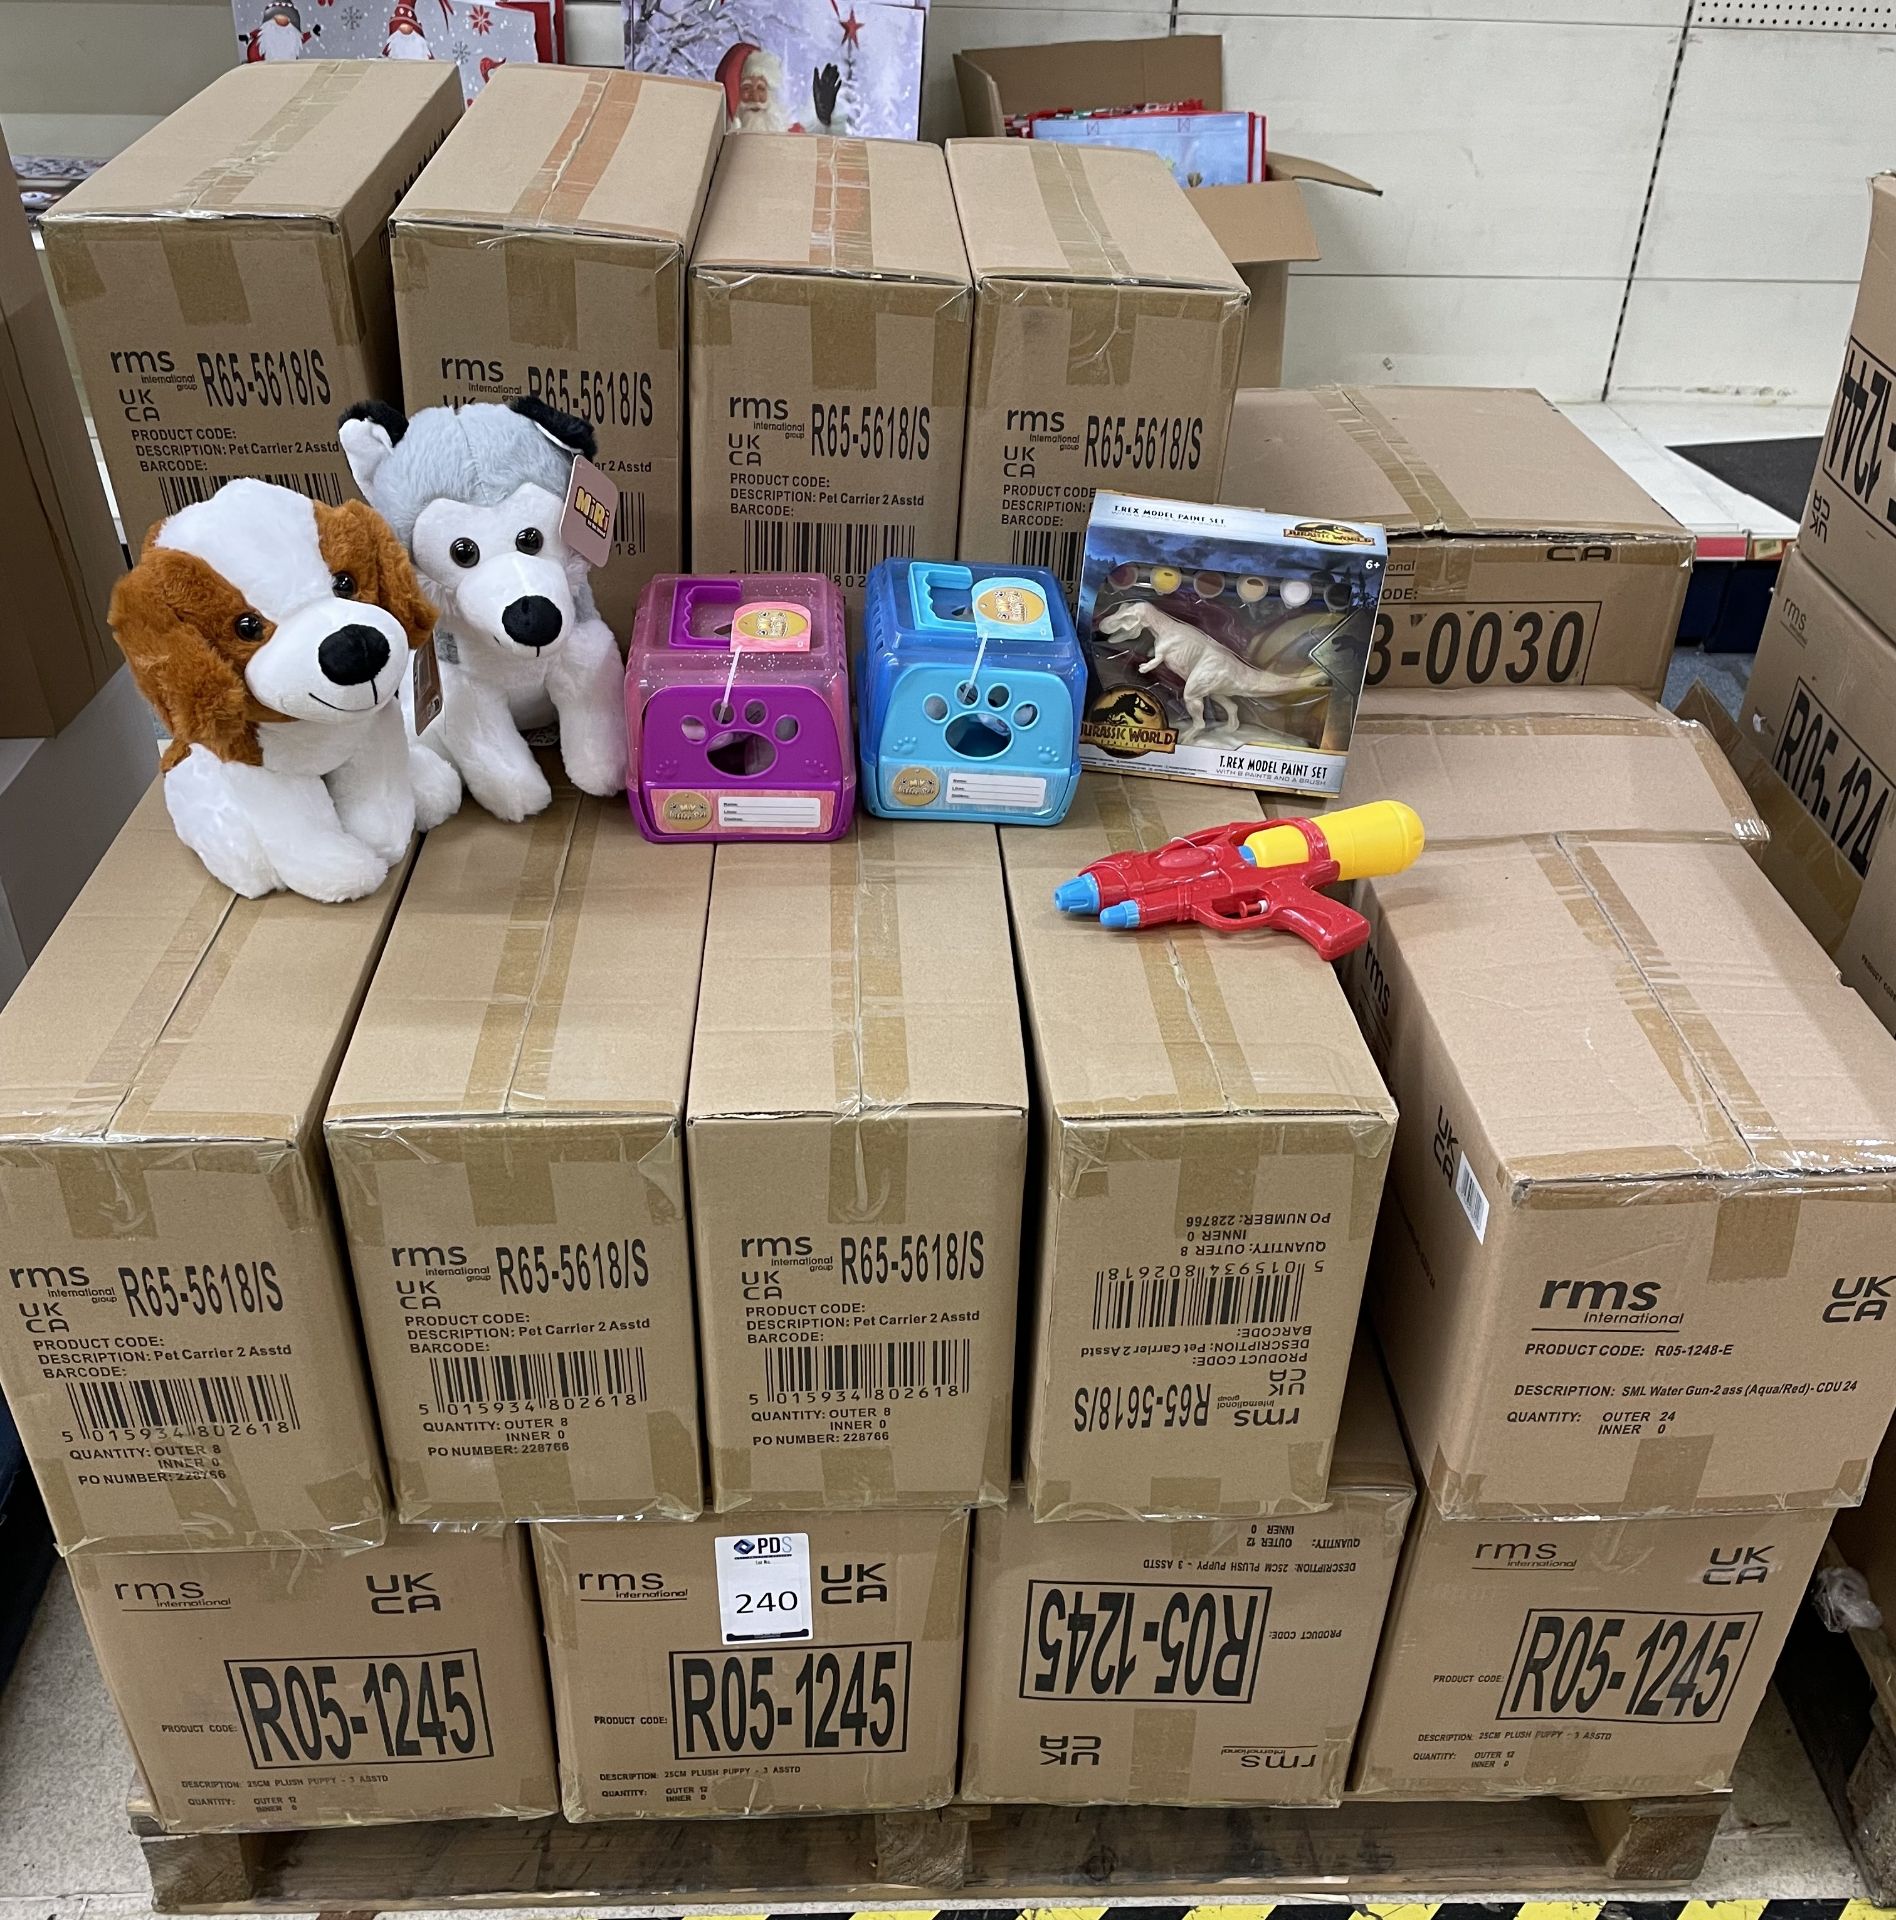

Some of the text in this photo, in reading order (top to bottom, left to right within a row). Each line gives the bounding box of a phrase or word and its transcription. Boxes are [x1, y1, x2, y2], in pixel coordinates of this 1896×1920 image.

[110, 351, 175, 373] rms
[441, 357, 504, 382] rms
[197, 349, 331, 408] R65-5618/S
[528, 366, 653, 426] R65-5618/S
[729, 396, 789, 419] rms
[1007, 409, 1065, 432] rms
[131, 428, 237, 441] PRODUCT CODE:
[811, 404, 930, 460] R65-5618/S
[136, 442, 339, 456] DESCRIPTION: Pet Carrier Asstd
[1084, 416, 1203, 470] R65-5618/S
[140, 460, 207, 471] BARCODE:
[617, 461, 652, 472] Asstd
[730, 473, 830, 488] PRODUCT CODE:
[730, 488, 924, 506] DESCRIPTION: Pet Carrier Asstd
[1003, 485, 1096, 498] PRODUCT CODE
[730, 504, 794, 517] BARCODE:
[1002, 500, 1086, 513] DESCRIPTION:
[1144, 509, 1173, 518] MODEL
[1002, 514, 1064, 527] BARCODE:
[1547, 546, 1611, 561] CA
[1366, 560, 1380, 569] 6+
[1383, 589, 1417, 600] ODE:
[1129, 728, 1174, 744] WORLD
[1220, 756, 1245, 769] T.REX
[1247, 759, 1277, 773] MODEL
[1281, 763, 1308, 776] PAINT
[1312, 767, 1327, 779] SET
[1245, 772, 1272, 780] PAINTS
[1775, 689, 1889, 879] R05-124
[1186, 1213, 1307, 1227] NUMBER: 228766
[742, 1236, 813, 1257] rms
[1196, 1241, 1326, 1256] QUANTITY: OUTER
[392, 1246, 467, 1267] rms
[771, 1256, 833, 1266] international
[840, 1231, 984, 1285] R65-5618/S
[425, 1266, 490, 1276] international
[496, 1239, 649, 1295] R65-5618/S
[9, 1266, 90, 1288] rms
[742, 1271, 779, 1285] UK
[48, 1288, 115, 1298] international
[118, 1261, 284, 1317] R65-5618/S
[396, 1281, 437, 1294] UK
[743, 1286, 782, 1300] CA
[1539, 1279, 1662, 1310] rms
[1831, 1275, 1896, 1300] UK
[400, 1297, 441, 1310] CA
[746, 1303, 865, 1317] PRODUCT CODE:
[1822, 1300, 1888, 1323] CA
[405, 1313, 530, 1327] PRODUCT CODE:
[746, 1311, 980, 1330] DESCRIPTION: Pet Carrier Asstd
[408, 1318, 650, 1340] DESCRIPTION: Pet Carrier Asstd
[33, 1336, 165, 1351] PRODUCT CODE:
[748, 1333, 824, 1344] BARCODE:
[38, 1345, 292, 1365] DESCRIPTION: Pet Carrier Asstd
[410, 1343, 490, 1353] BARCODE:
[1524, 1344, 1734, 1357] PRODUCT CODE: R05-1248-E
[42, 1367, 127, 1379] BARCODE:
[1514, 1385, 1616, 1397] DESCRIPTION:
[1621, 1385, 1647, 1397] SML
[1650, 1384, 1683, 1396] Water
[1723, 1386, 1743, 1395] ass
[1816, 1381, 1841, 1393] CDU
[1843, 1381, 1858, 1392] 24
[751, 1408, 877, 1421] QUANTITY: OUTER
[1074, 1384, 1211, 1432] R65-5618/S
[1234, 1408, 1300, 1426] rms
[1506, 1411, 1676, 1423] QUANTITY: OUTER 24
[423, 1419, 554, 1432] QUANTITY: OUTER
[830, 1420, 872, 1431] INNER
[1598, 1425, 1641, 1435] INNER
[506, 1431, 551, 1442] INNER
[753, 1432, 889, 1446] PO NUMBER: 228766
[69, 1445, 204, 1460] QUANTITY: OUTER
[428, 1442, 570, 1456] PO NUMBER: 228766
[103, 1473, 173, 1484] NUMBER:
[758, 1536, 792, 1553] PDS
[1475, 1543, 1557, 1559] rms
[1709, 1545, 1775, 1565] UK
[821, 1562, 888, 1584] UK
[1143, 1559, 1289, 1573] 25CM PLUSH PUPPY ASSTD
[365, 1572, 436, 1593] UK
[578, 1572, 664, 1590] rms
[1702, 1567, 1768, 1585] CA
[114, 1580, 204, 1600] rms
[615, 1588, 688, 1599] international
[821, 1584, 888, 1604] CA
[371, 1595, 441, 1614] CA
[735, 1591, 799, 1614] 240
[1034, 1588, 1258, 1697] R05-1245
[1509, 1616, 1746, 1717] R05-1245
[1433, 1675, 1475, 1683] PRODUCT
[681, 1651, 897, 1752] R05-1245
[238, 1659, 478, 1761] R05-1245
[593, 1716, 668, 1724] PRODUCT CODE:
[161, 1724, 204, 1733] PRODUCT
[1240, 1755, 1316, 1769] rms
[691, 1769, 719, 1778] PLUSH
[722, 1768, 750, 1776] PUPPY
[773, 1766, 801, 1774] ASSTD
